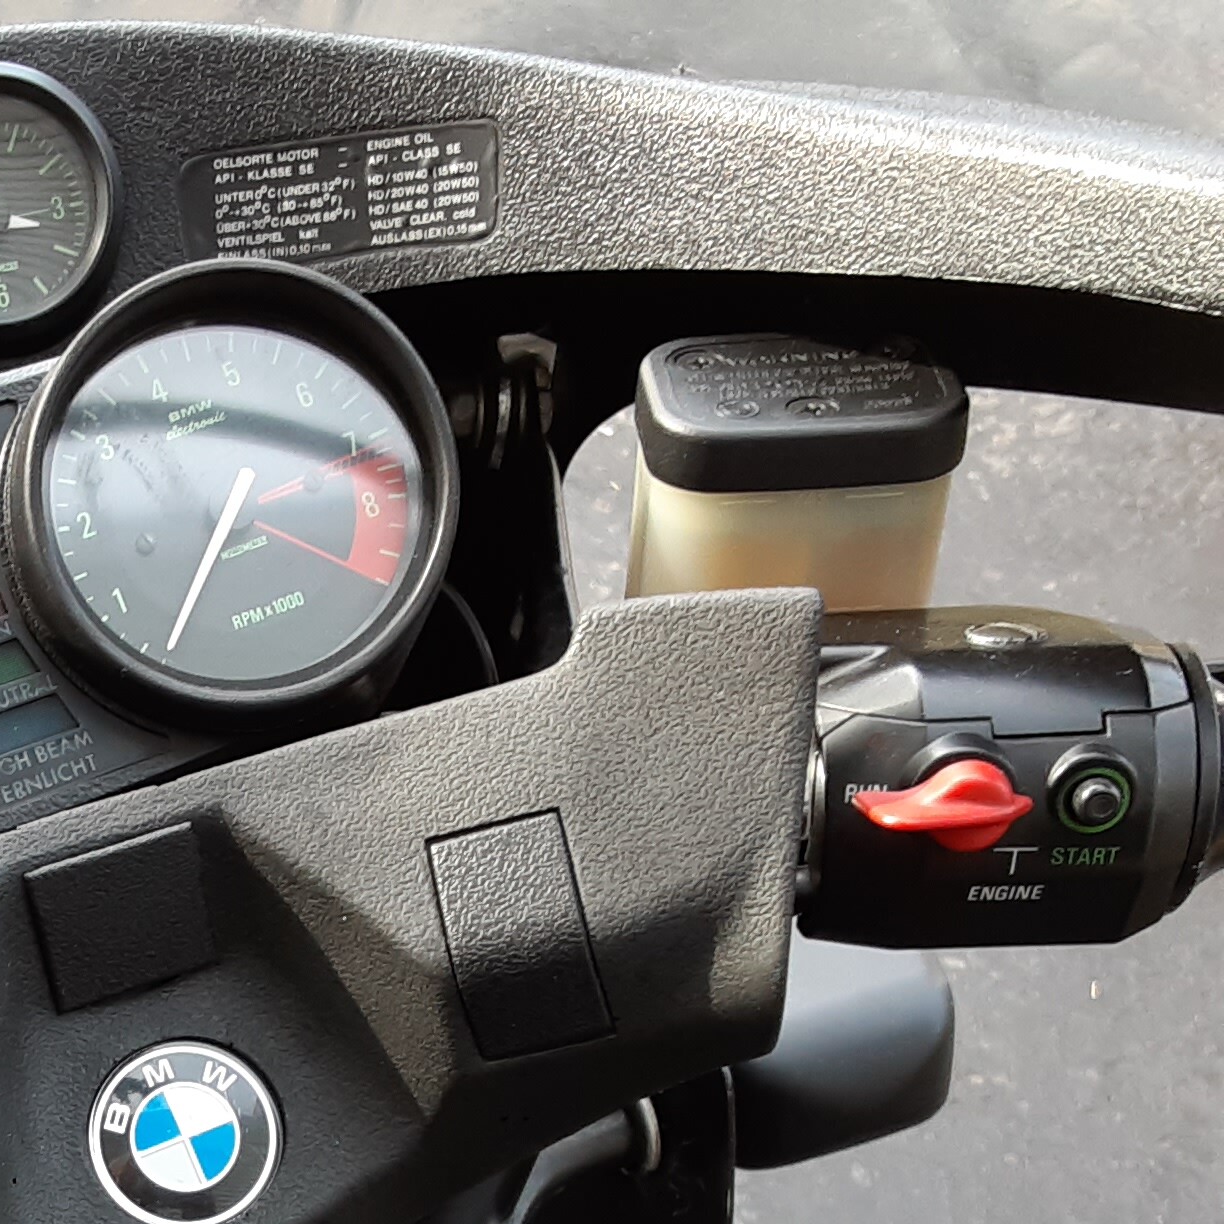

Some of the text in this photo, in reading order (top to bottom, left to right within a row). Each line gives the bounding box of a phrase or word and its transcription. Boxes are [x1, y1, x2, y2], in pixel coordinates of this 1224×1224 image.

[367, 133, 434, 151] ENGINE OIL
[368, 154, 388, 166] API
[402, 146, 440, 162] CLASS
[446, 142, 461, 155] SE
[214, 153, 274, 170] OELSORTE
[277, 148, 319, 162] MOTOR
[215, 172, 235, 184] API
[247, 165, 293, 181] KLASSE
[298, 163, 315, 175] SE
[51, 196, 65, 220] 3
[370, 216, 403, 231] VALVE
[410, 211, 447, 226] CLEAR.
[217, 232, 285, 248] VENTILSPIEL
[222, 362, 240, 386] 5
[152, 378, 168, 403] 4
[296, 383, 314, 408] 6
[168, 399, 212, 423] BMW
[96, 435, 116, 460] 3
[341, 431, 357, 457] 7
[362, 492, 380, 518] 8
[76, 512, 97, 539] 2
[112, 588, 128, 614] 1
[34, 730, 94, 764] BEAM
[1050, 846, 1120, 866] START
[967, 884, 1045, 902] ENGINE
[104, 1058, 237, 1135] BMW
